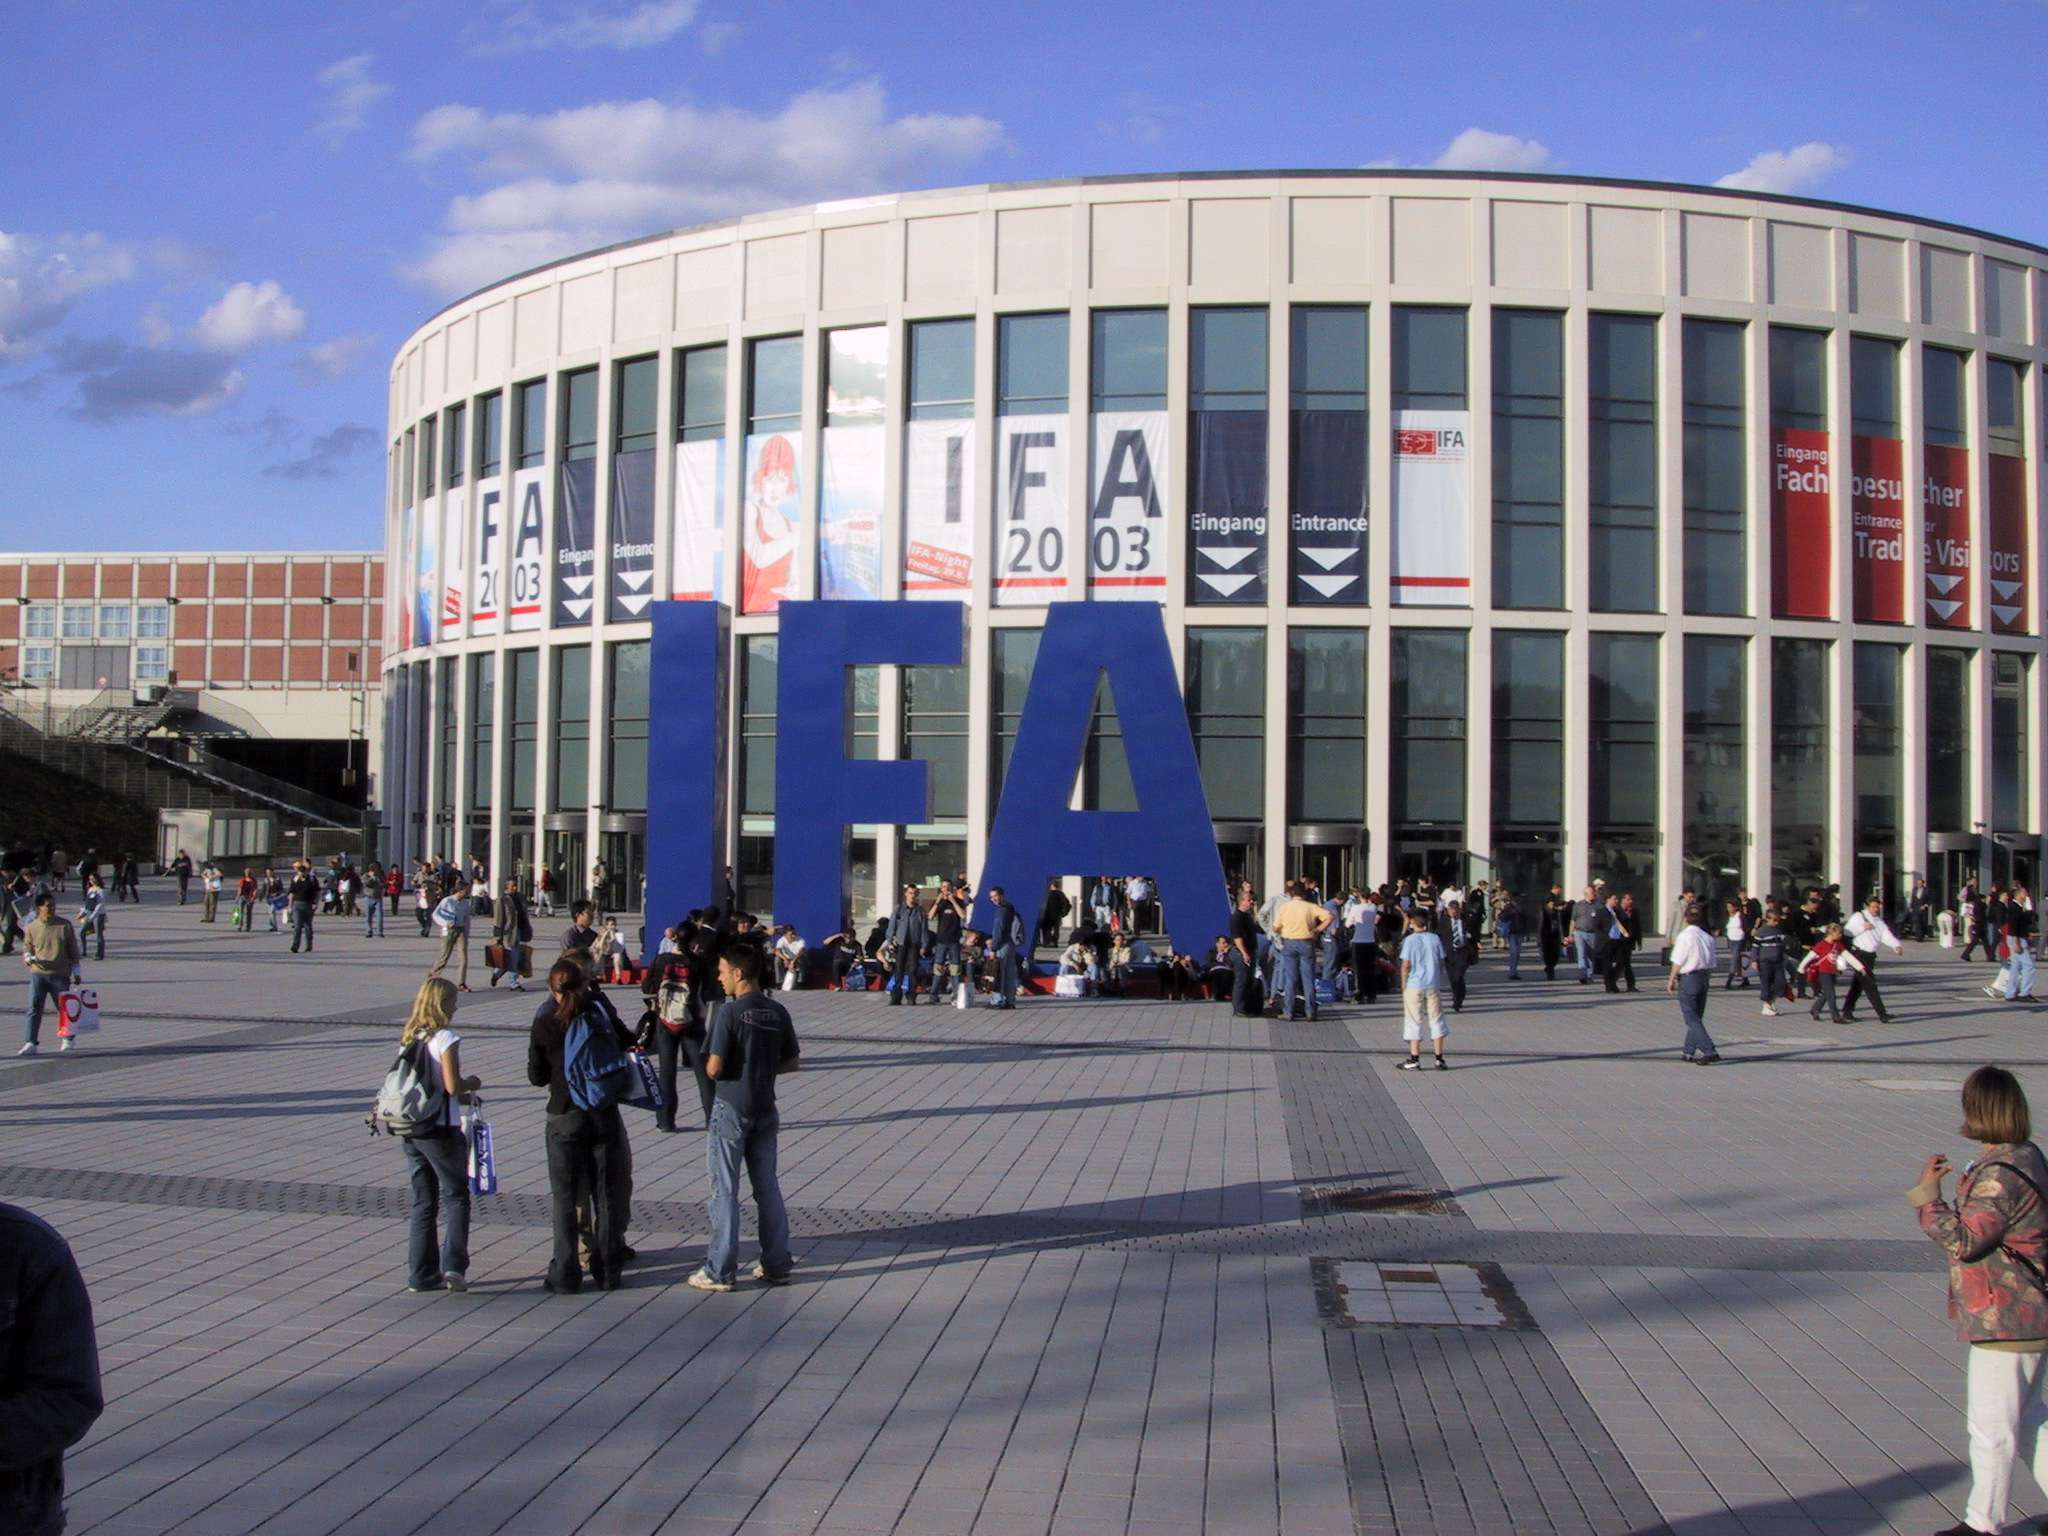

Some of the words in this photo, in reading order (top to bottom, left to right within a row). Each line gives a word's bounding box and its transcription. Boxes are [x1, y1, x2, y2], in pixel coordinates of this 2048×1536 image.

[1438, 431, 1465, 447] IFA
[1776, 443, 1828, 464] Eingang
[1191, 513, 1267, 535] Eingang
[1292, 513, 1367, 532] Entrance
[1854, 511, 1903, 530] Entrance
[559, 548, 594, 566] Eingan
[613, 543, 654, 559] Entranc
[644, 600, 1234, 962] IFA
